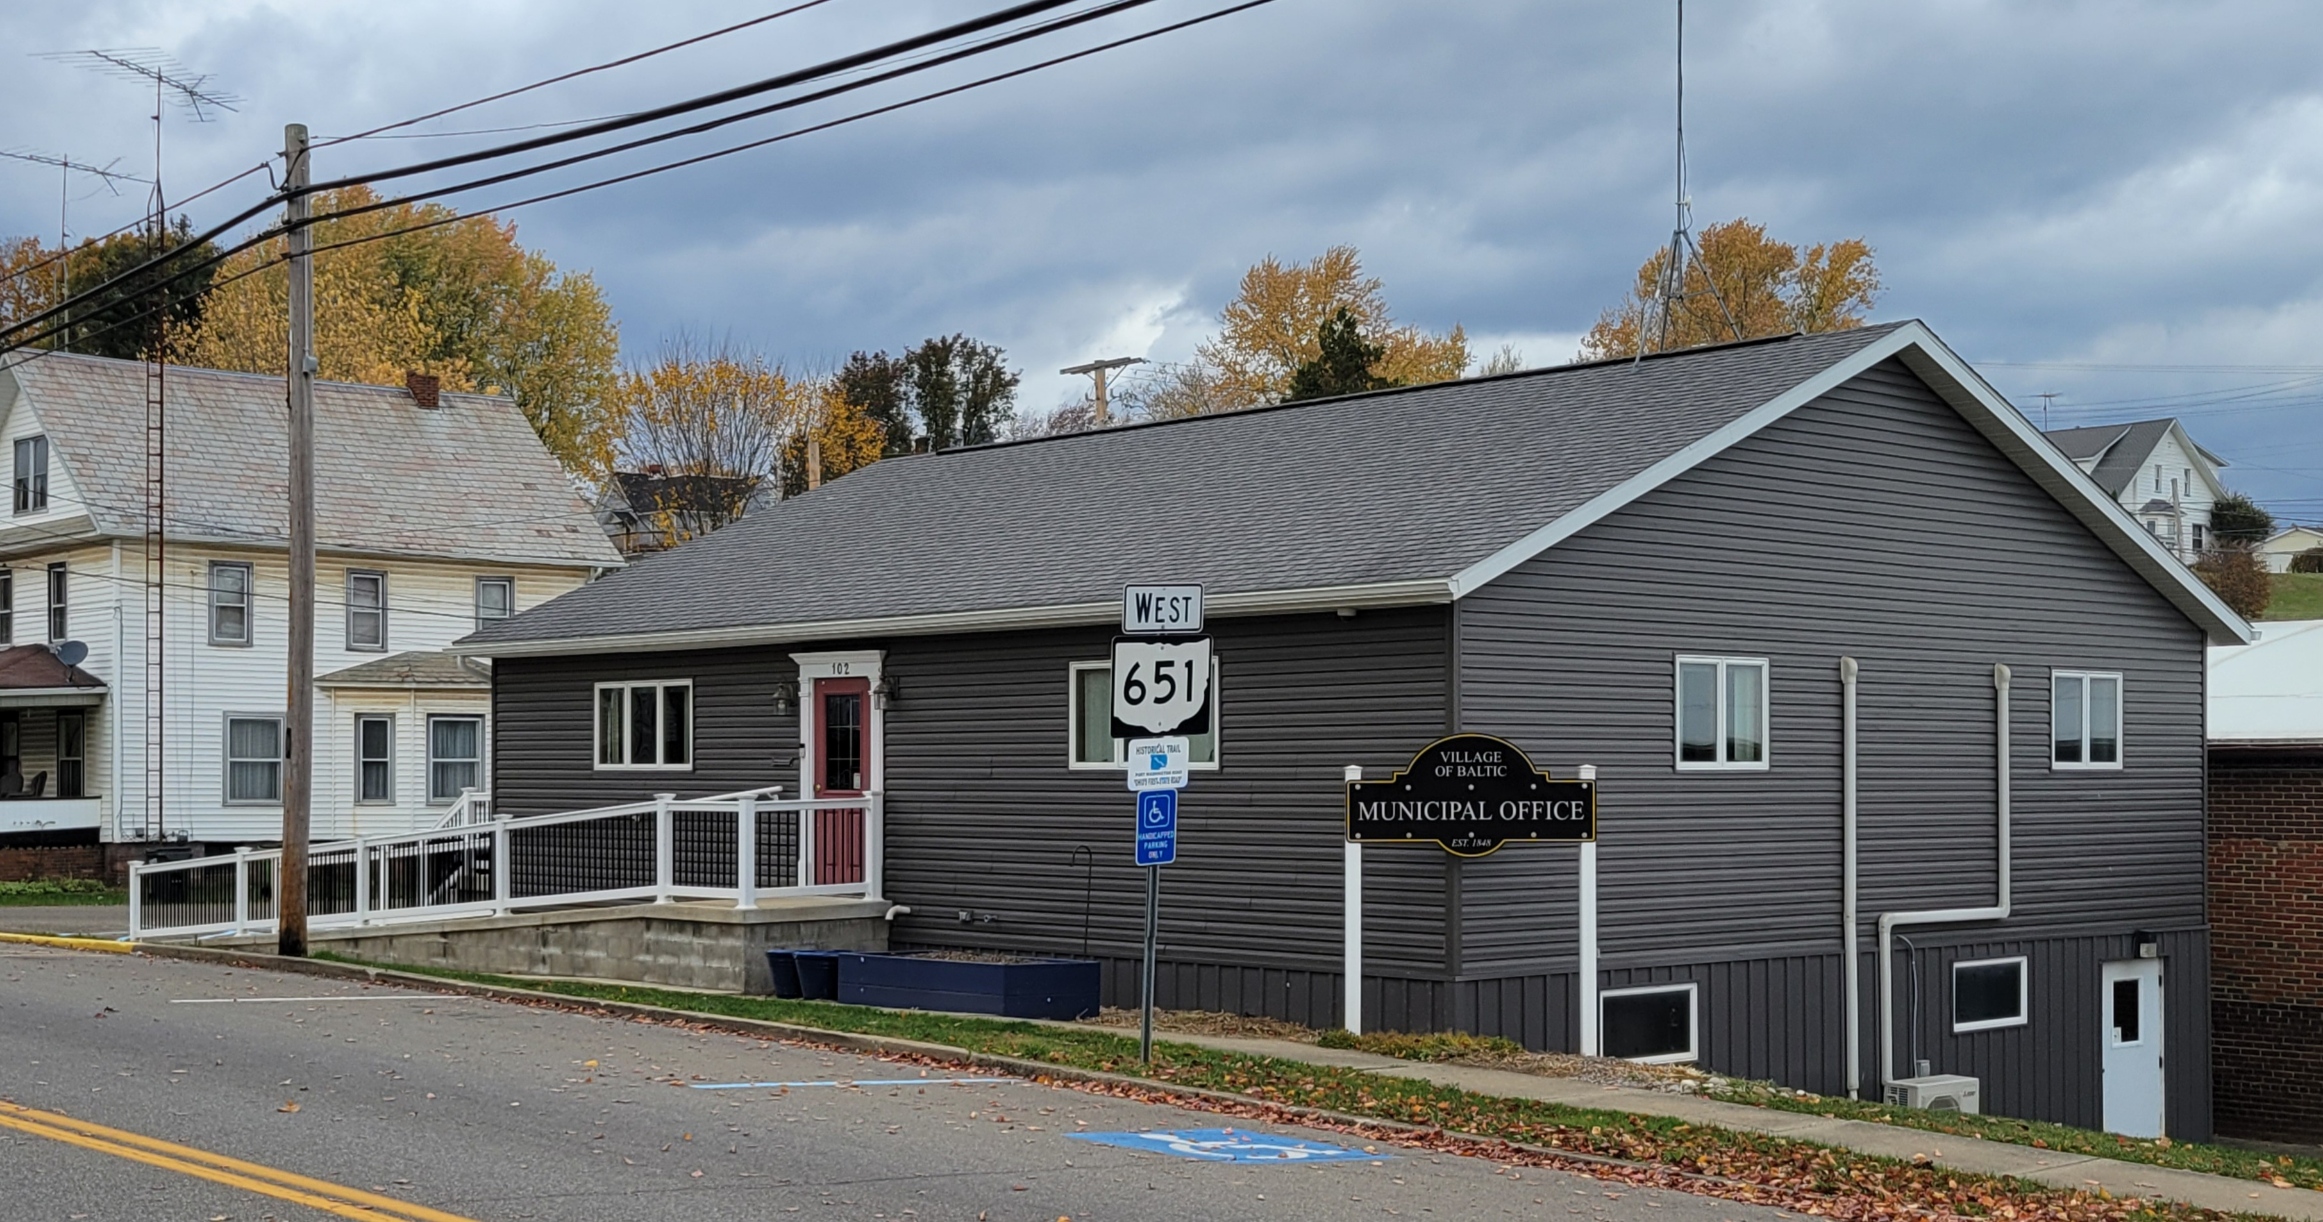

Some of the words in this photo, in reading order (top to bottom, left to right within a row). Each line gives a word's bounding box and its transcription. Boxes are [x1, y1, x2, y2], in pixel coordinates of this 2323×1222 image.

[1135, 592, 1192, 623] WEST
[832, 662, 850, 675] 102
[1123, 659, 1194, 706] 651
[1136, 744, 1165, 755] HISTORICAL
[1167, 744, 1181, 754] TRAIL
[1440, 751, 1502, 763] VILLAGE
[1435, 766, 1453, 777] OF
[1457, 765, 1507, 777] BALTIC
[1357, 801, 1493, 821] MUNICIPAL
[1499, 800, 1585, 821] OFFICE
[1138, 831, 1174, 840] HANDICAPPED
[1144, 841, 1168, 849] PARKING
[1451, 839, 1470, 848] EST.
[1472, 838, 1492, 848] 1848
[1148, 851, 1163, 859] ONLY
